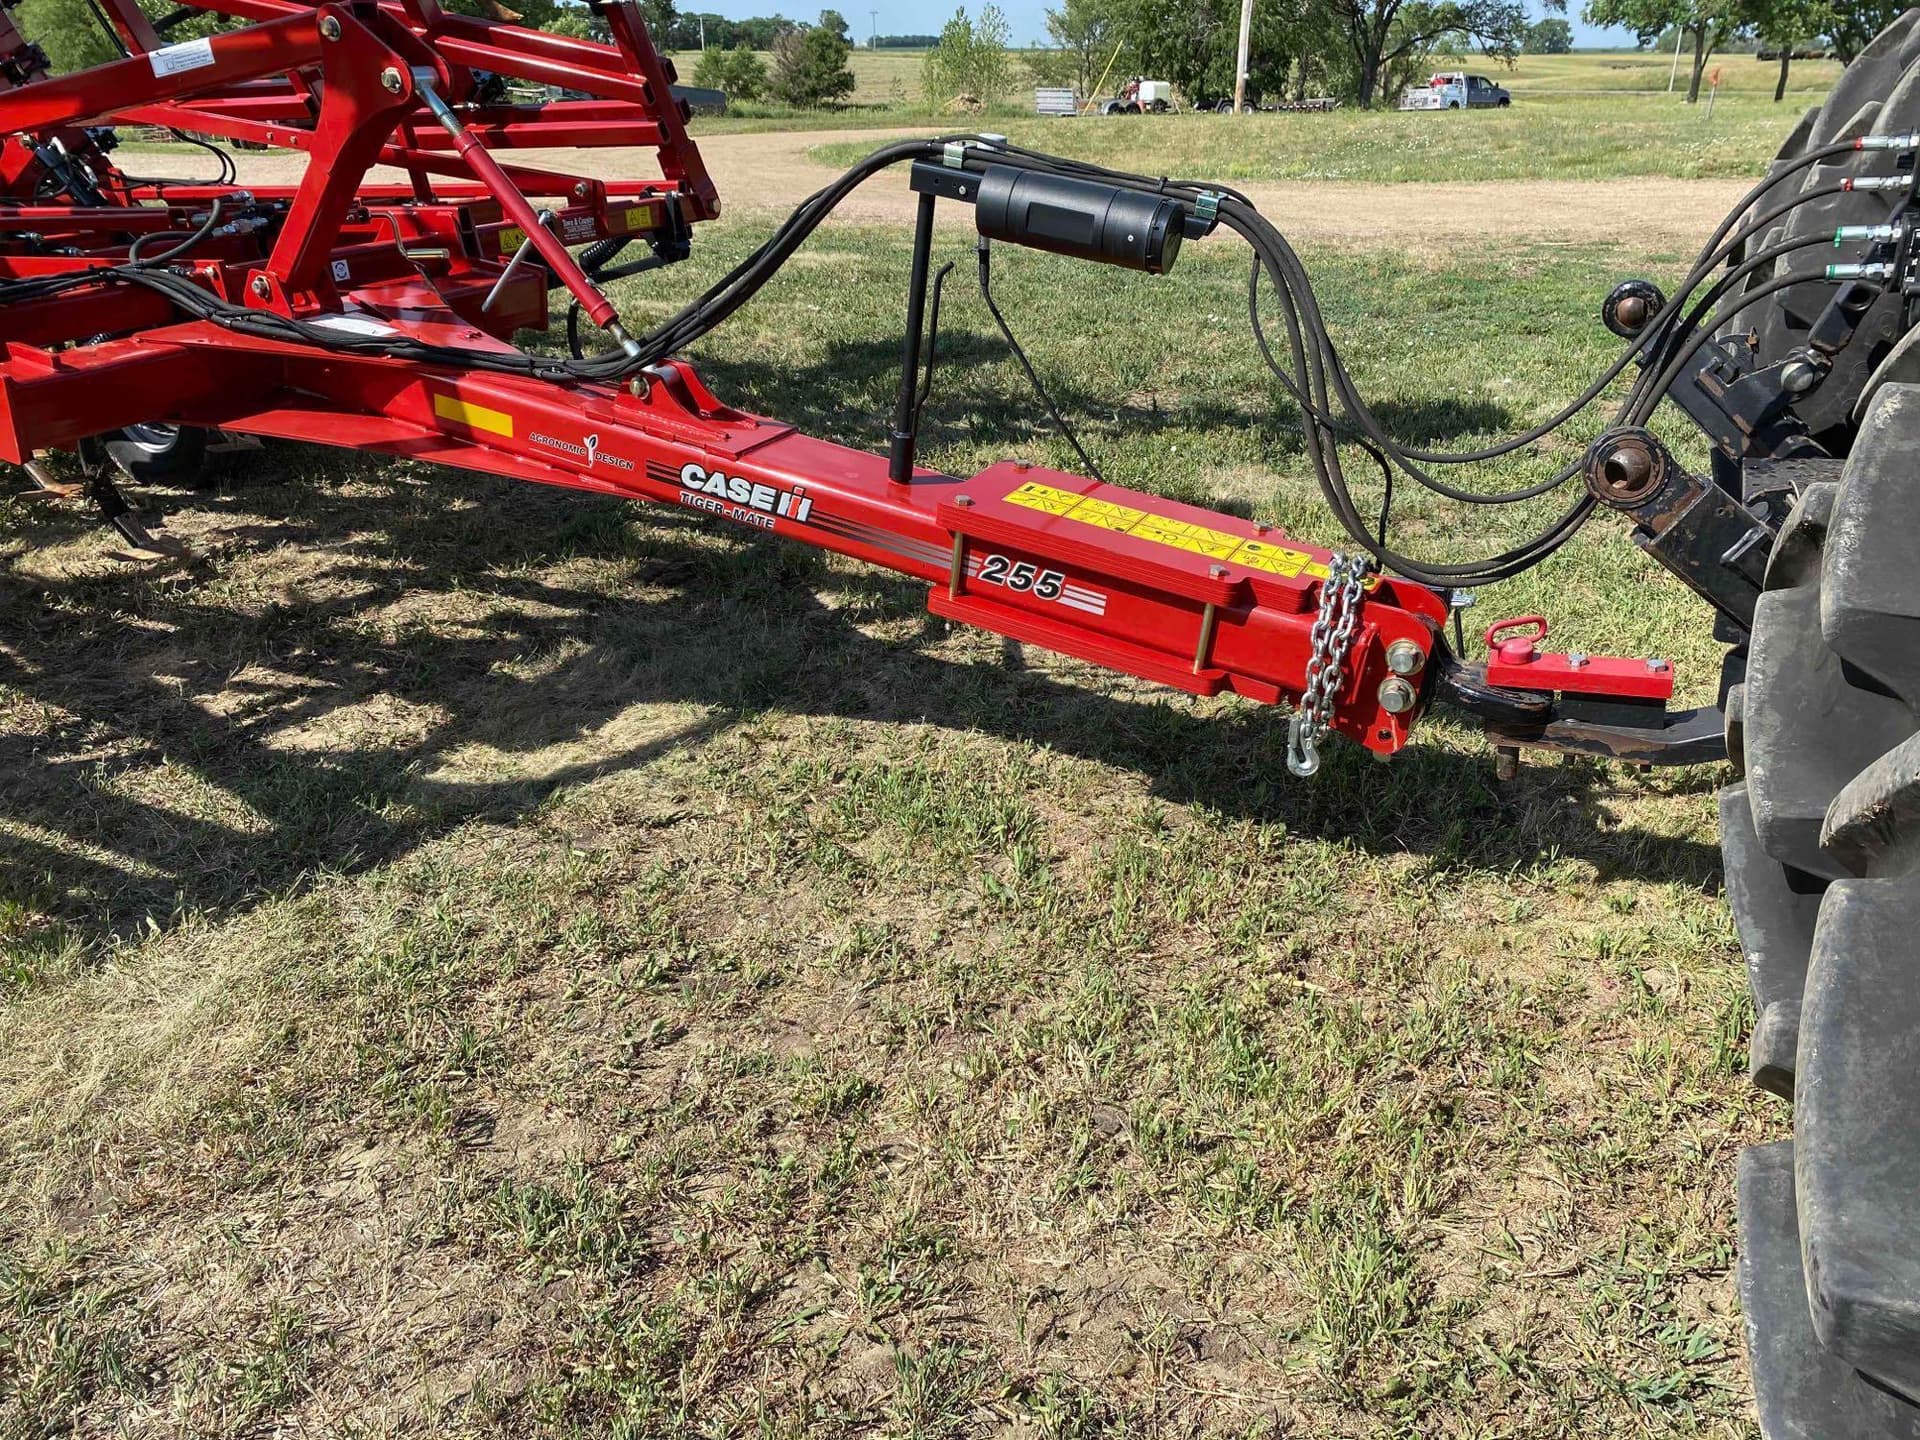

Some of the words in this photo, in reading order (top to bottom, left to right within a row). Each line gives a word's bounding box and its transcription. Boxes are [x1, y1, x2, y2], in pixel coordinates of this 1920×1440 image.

[529, 432, 586, 456] AGRONOMIC
[594, 451, 634, 471] DESIGN
[680, 463, 777, 511] CASE
[679, 492, 775, 529] TIGER-MATE
[978, 554, 1066, 601] 255
